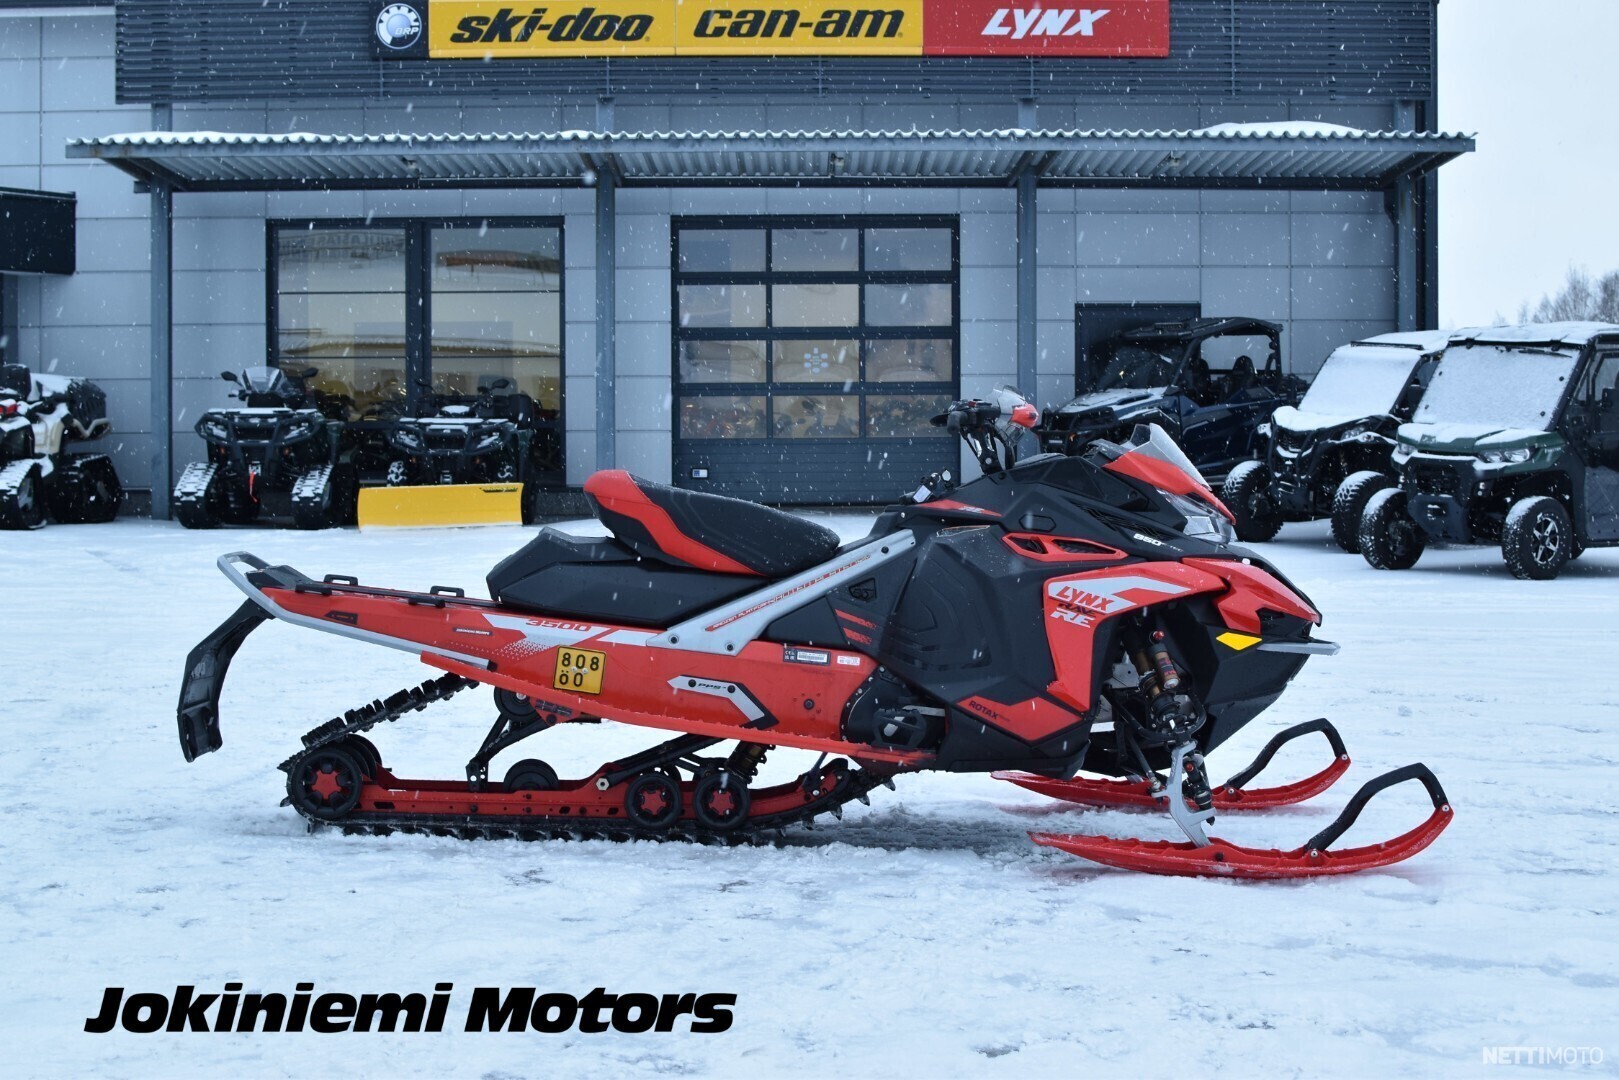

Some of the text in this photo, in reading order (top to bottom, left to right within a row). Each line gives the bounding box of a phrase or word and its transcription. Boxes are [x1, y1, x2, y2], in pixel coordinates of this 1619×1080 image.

[395, 27, 419, 35] BRP
[450, 7, 653, 43] ski-doo
[693, 8, 904, 38] can-am
[980, 9, 1111, 39] LYNX
[1056, 585, 1115, 611] LYNX
[525, 618, 592, 632] 3500
[1050, 607, 1096, 628] RE
[562, 652, 599, 671] 808
[968, 700, 999, 720] ROTAX
